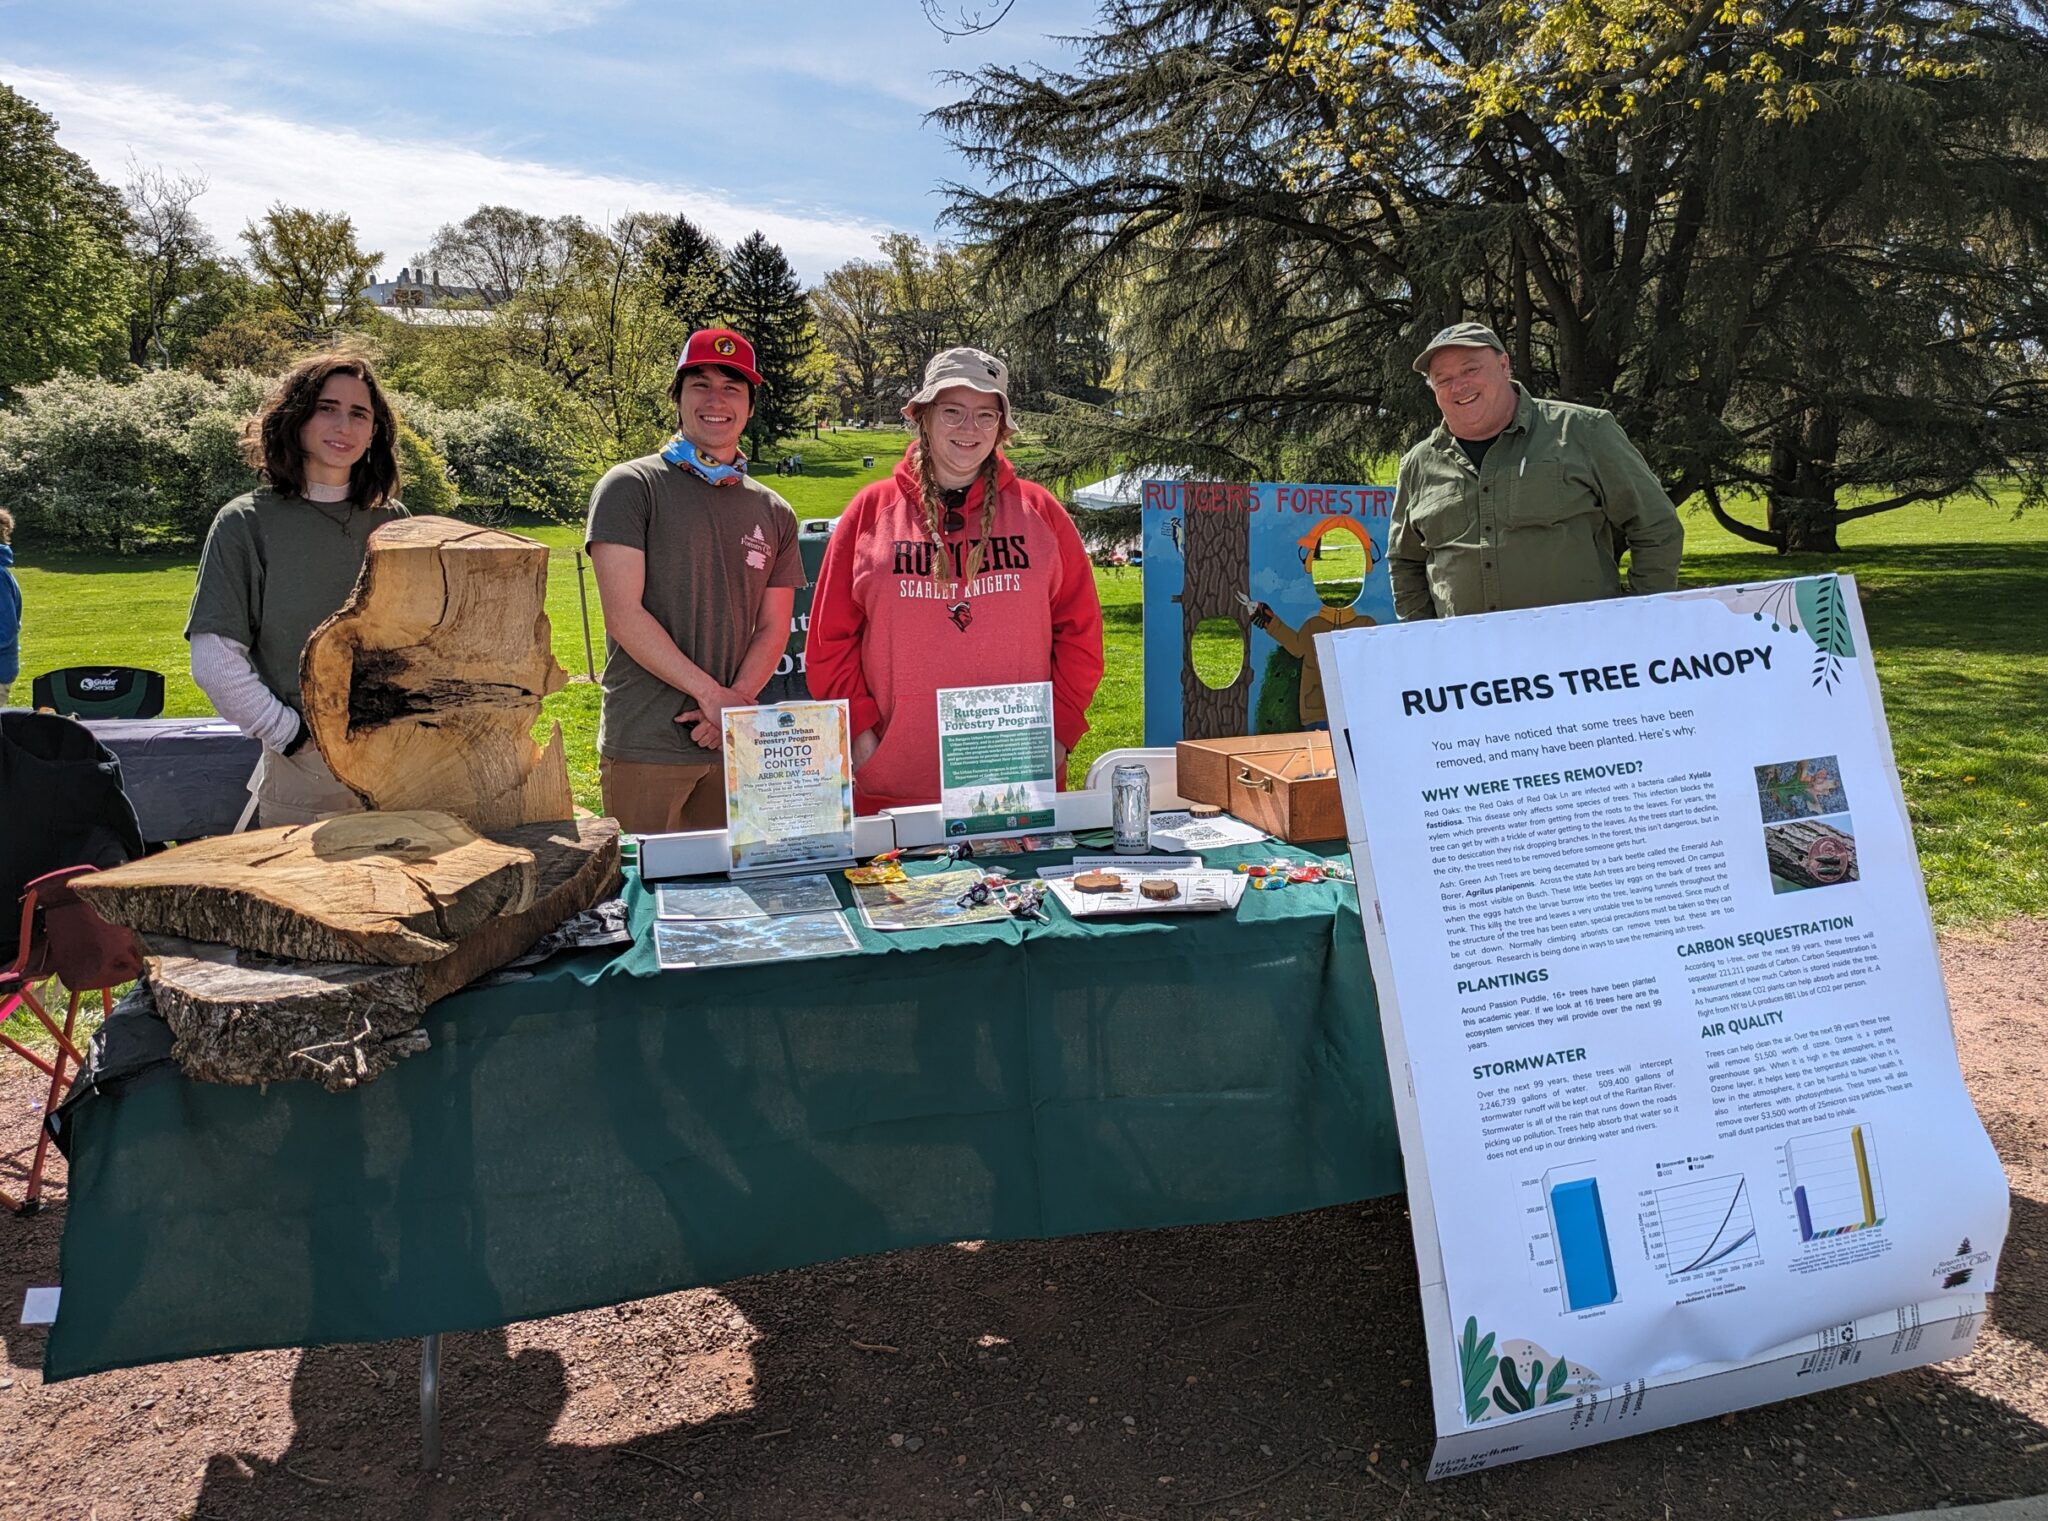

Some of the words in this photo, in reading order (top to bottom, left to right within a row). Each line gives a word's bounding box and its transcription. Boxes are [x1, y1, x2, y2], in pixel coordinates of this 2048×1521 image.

[1145, 484, 1260, 512] RUTGERS
[900, 580, 958, 600] SCARLET
[964, 574, 1020, 598] KNIGHTS
[1402, 674, 1554, 716] RUTGERS
[1558, 663, 1640, 695] TREE
[1649, 645, 1772, 684] CANOPY
[945, 719, 994, 731] Forestry
[998, 716, 1047, 727] Program
[954, 708, 1000, 719] Rutgers
[1003, 704, 1039, 714] Urban
[754, 737, 786, 745] Forestry
[788, 735, 820, 743] Program
[760, 730, 790, 738] Rutgers
[1432, 741, 1453, 751] You
[1457, 738, 1480, 748] may
[1485, 734, 1510, 744] have
[1514, 726, 1552, 740] noticed
[1556, 724, 1578, 735] that
[1581, 721, 1609, 731] some
[1612, 717, 1638, 727] trees
[1640, 713, 1665, 723] have
[1668, 710, 1694, 719] been
[764, 745, 812, 759] PHOTO
[1436, 753, 1486, 768] removed,
[1488, 749, 1508, 762] and
[1511, 748, 1539, 758] many
[1541, 744, 1567, 754] have
[1568, 740, 1594, 750] been
[1596, 732, 1637, 748] planted.
[1638, 728, 1671, 741] Here's
[1672, 725, 1696, 736] why:
[758, 772, 784, 780] ARBOR
[785, 770, 800, 778] DAY
[765, 758, 812, 769] CONTEST
[1421, 786, 1459, 802] WHY
[1463, 779, 1510, 797] WERE
[1512, 772, 1561, 789] TREES
[1564, 760, 1643, 783] REMOVED?
[1424, 809, 1439, 818] Red
[1441, 807, 1462, 815] Oaks:
[1479, 801, 1494, 810] Red
[1496, 799, 1514, 807] Oaks
[1517, 797, 1524, 805] of
[1526, 795, 1541, 803] Red
[1543, 793, 1557, 801] Oak
[1585, 785, 1611, 794] infected
[1637, 778, 1664, 787] bacteria
[1667, 774, 1686, 783] called
[1689, 771, 1711, 780] Xylella
[1426, 819, 1464, 829] fastidiosa.
[1485, 812, 1510, 821] disease
[1513, 809, 1527, 817] only
[1530, 806, 1553, 814] affects
[1555, 803, 1574, 811] some
[1576, 799, 1601, 808] species
[1603, 796, 1610, 804] of
[1650, 788, 1678, 797] infection
[1680, 784, 1702, 792] blocks
[1677, 936, 1735, 957] CARBON
[1737, 915, 1854, 947] SEQUESTRATION
[1457, 968, 1549, 994] PLANTINGS
[1461, 1004, 1486, 1015] Around
[1489, 1000, 1518, 1010] Passion
[1520, 994, 1549, 1004] Puddle,
[1569, 989, 1588, 997] trees
[1591, 985, 1609, 994] have
[1611, 982, 1630, 990] been
[1632, 976, 1656, 988] planted
[1701, 1023, 1726, 1039] AIR
[1728, 1010, 1783, 1035] QUALITY
[1468, 1041, 1488, 1052] years.
[1473, 1048, 1587, 1079] STORMWATER
[1477, 1090, 1494, 1099] Over
[1514, 1083, 1530, 1092] next
[1533, 1080, 1544, 1089] 99
[1572, 1072, 1592, 1081] these
[1595, 1068, 1615, 1077] trees
[1618, 1064, 1631, 1073] will
[1640, 1058, 1673, 1069] intercept
[1521, 1093, 1548, 1104] gallons
[1552, 1088, 1560, 1097] of
[1634, 1073, 1661, 1084] gallons
[1666, 1069, 1674, 1077] of
[1932, 1263, 1966, 1276] Forestry
[1676, 1296, 1705, 1306] Breakdown
